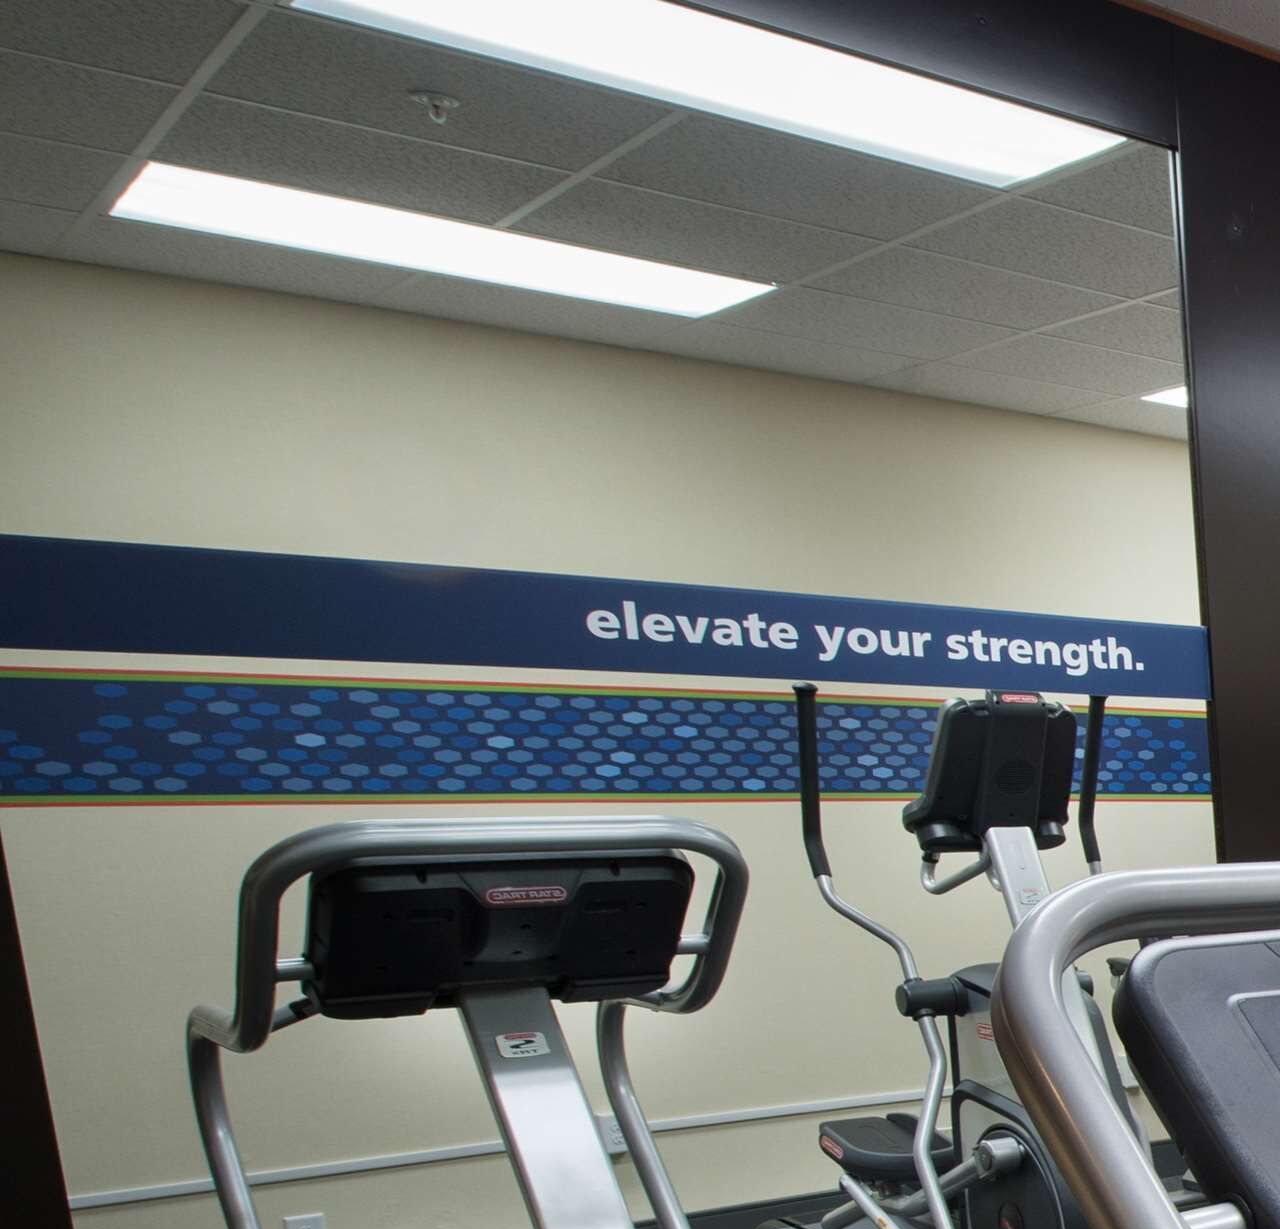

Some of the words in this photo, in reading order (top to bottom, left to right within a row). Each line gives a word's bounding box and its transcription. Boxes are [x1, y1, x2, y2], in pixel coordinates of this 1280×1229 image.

[585, 600, 800, 650] elevate
[813, 624, 932, 662] your
[945, 629, 1145, 677] strength.
